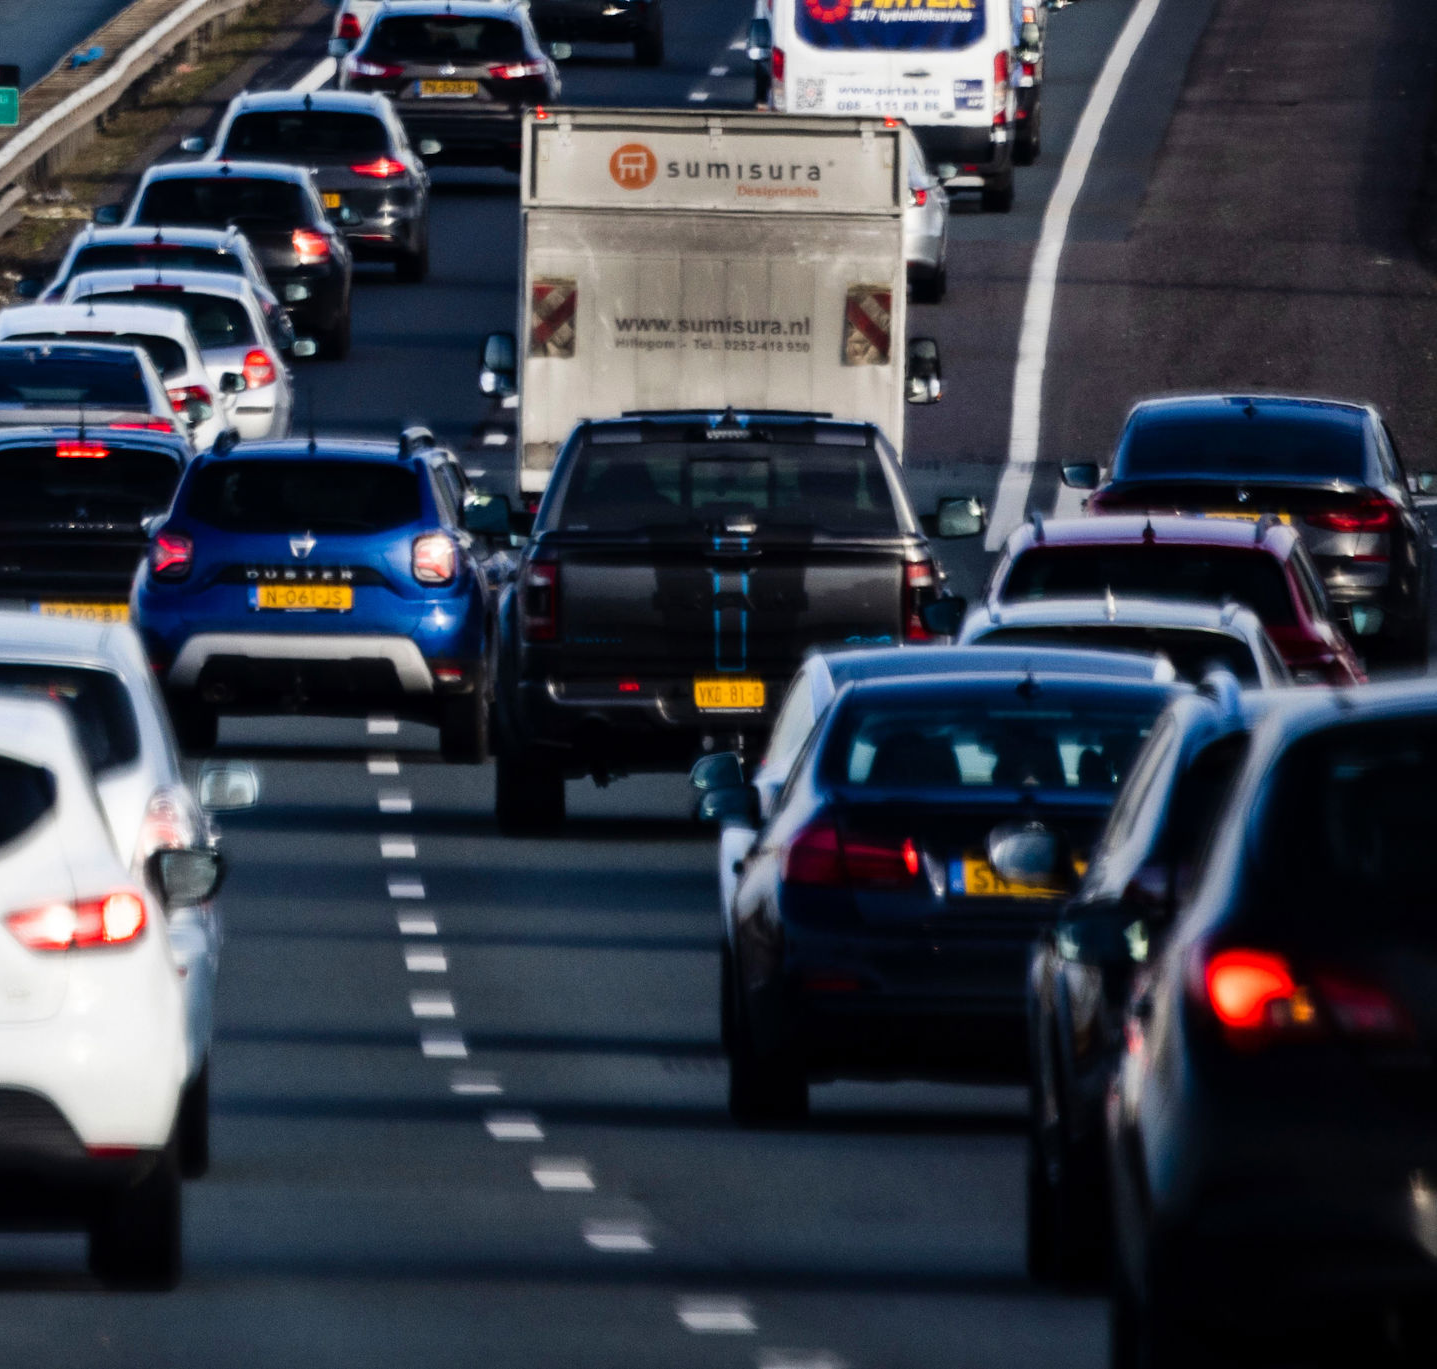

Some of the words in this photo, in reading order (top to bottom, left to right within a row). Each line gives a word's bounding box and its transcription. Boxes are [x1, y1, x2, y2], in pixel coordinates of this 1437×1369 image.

[667, 160, 821, 181] sumisura
[615, 316, 811, 336] www.sumisura.nl
[246, 568, 354, 580] DUSTER
